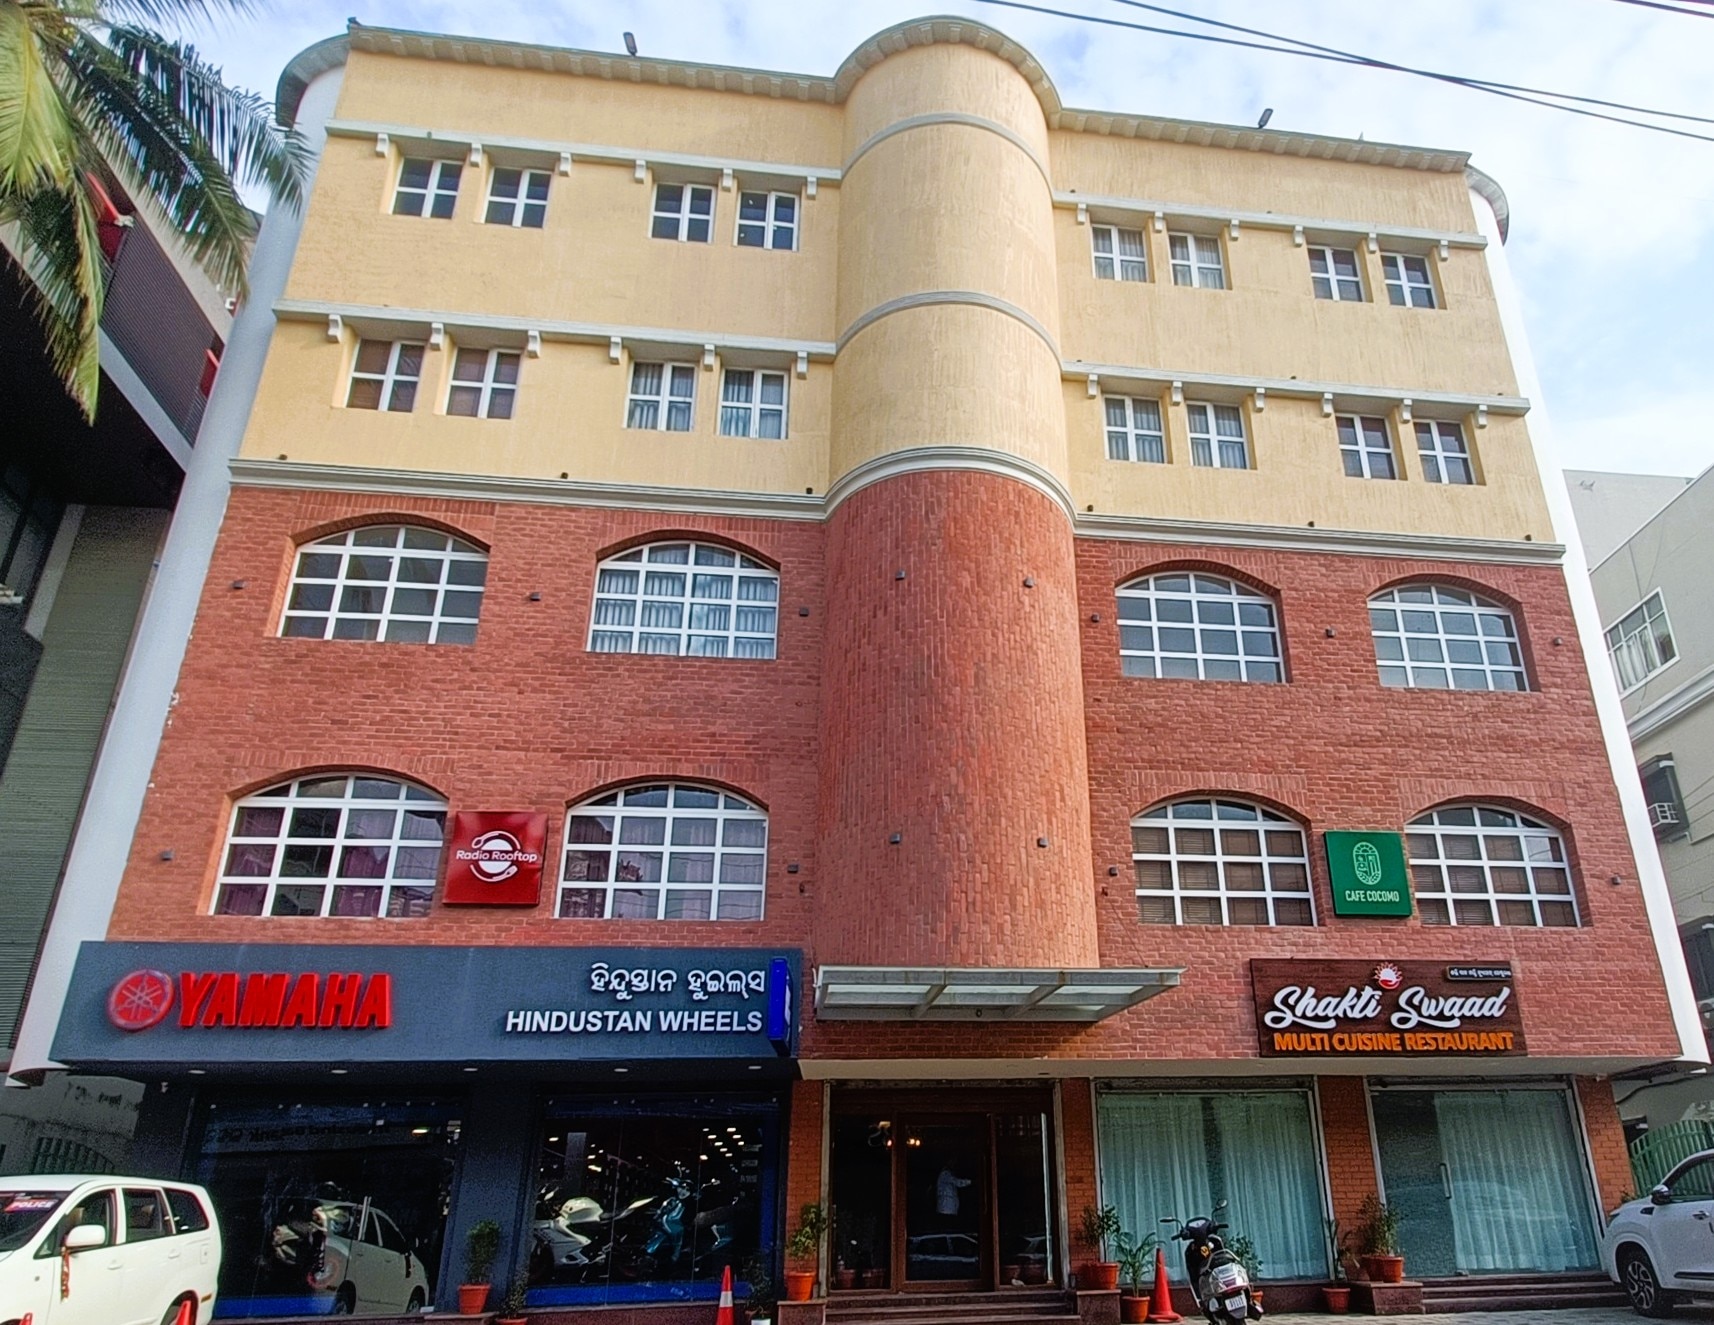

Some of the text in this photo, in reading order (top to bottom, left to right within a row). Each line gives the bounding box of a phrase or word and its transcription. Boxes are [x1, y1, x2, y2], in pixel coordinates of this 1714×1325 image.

[456, 850, 537, 862] Radio Rooftop
[1345, 890, 1400, 902] CAFE COCOMO
[178, 971, 393, 1029] YAMAHA
[1264, 985, 1511, 1029] Shakti Swaad
[505, 1010, 763, 1033] HINDUSTAN WHEELS
[1273, 1032, 1514, 1051] MULTI CUISINE RESTAURANT
